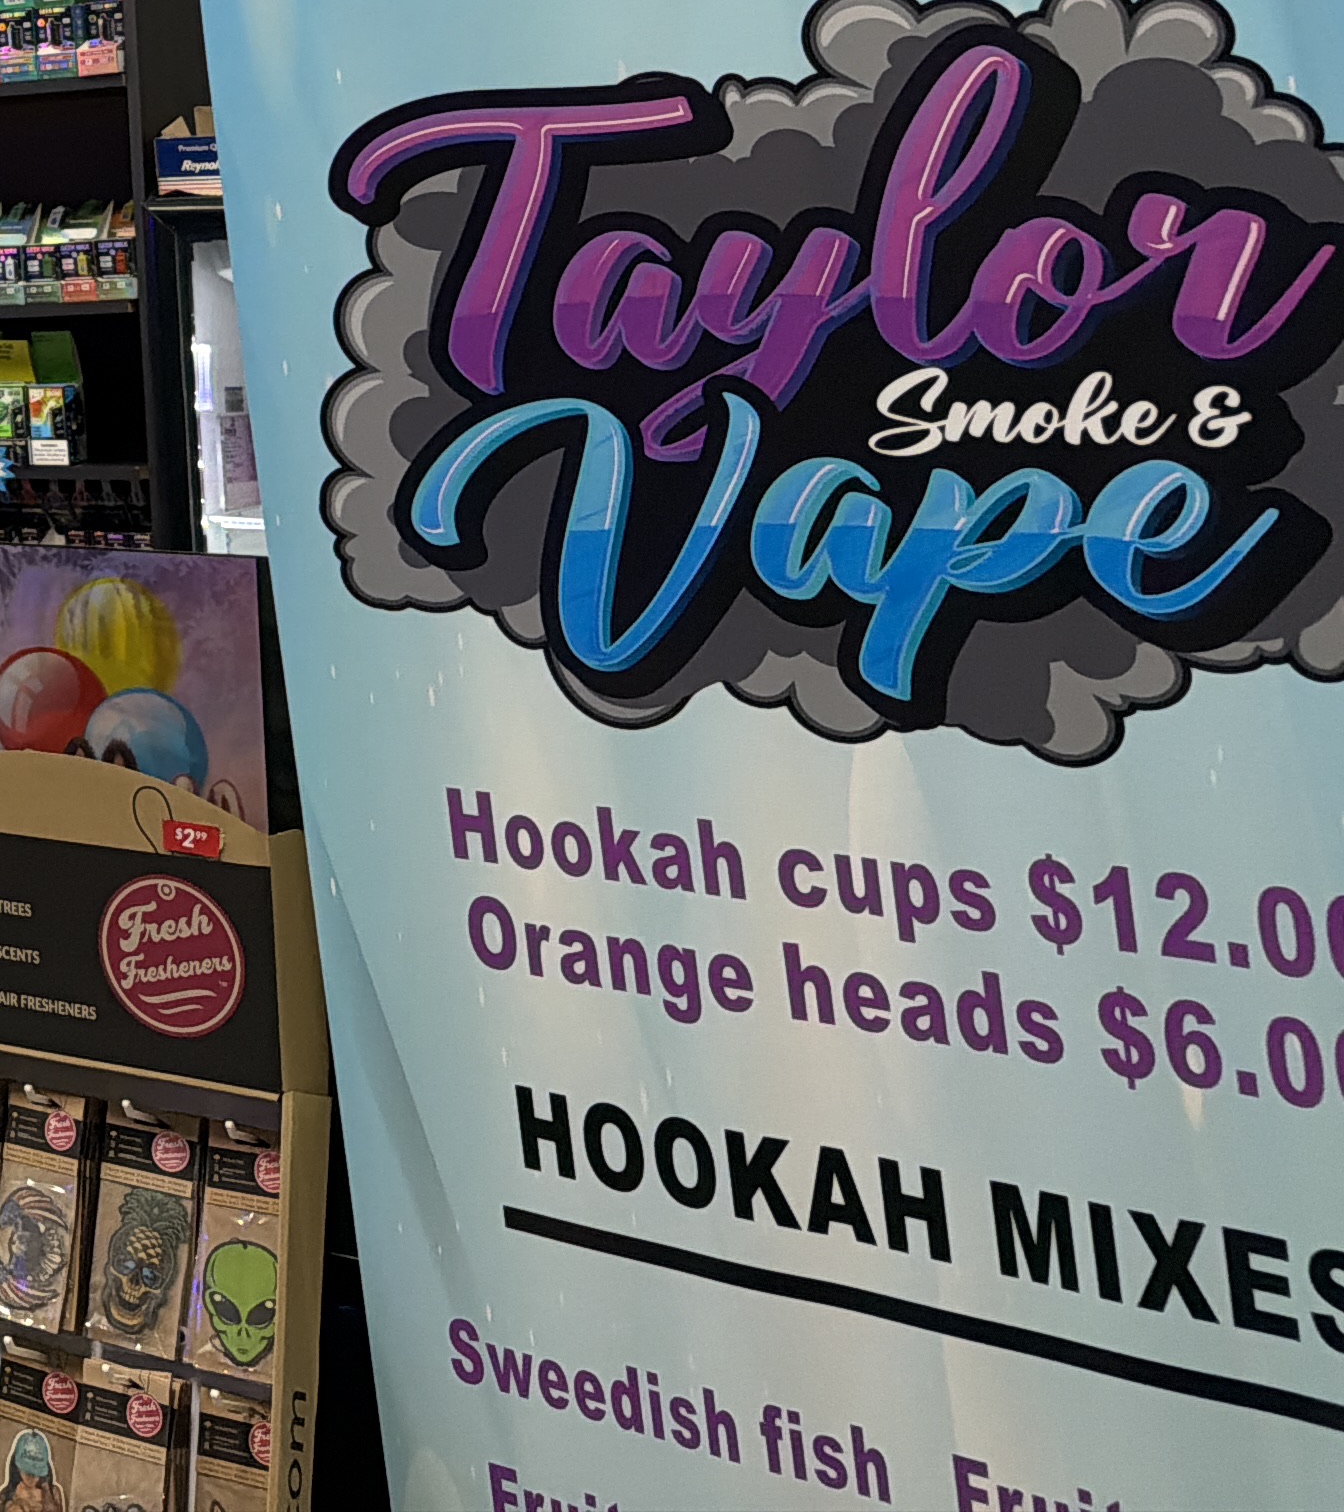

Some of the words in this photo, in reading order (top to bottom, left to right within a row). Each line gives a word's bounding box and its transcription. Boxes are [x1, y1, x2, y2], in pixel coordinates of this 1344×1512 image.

[181, 160, 219, 173] Reynol
[343, 43, 1337, 463] Taylor
[867, 366, 1178, 456] Smoke
[1186, 383, 1251, 449] &
[408, 388, 1280, 701] Vape
[117, 900, 213, 953] Fresh
[119, 954, 233, 990] Fresheners
[445, 786, 748, 902] Hookah
[777, 842, 998, 944] cups
[1027, 853, 1344, 980] $12.0
[20, 994, 97, 1021] FRESHENERS
[467, 894, 755, 1024] Orange
[782, 942, 1066, 1066] heads
[1097, 987, 1344, 1110] $6.0
[513, 1082, 954, 1265] HOOKAH
[447, 1318, 742, 1465] Sweedish
[760, 1403, 893, 1505] fish
